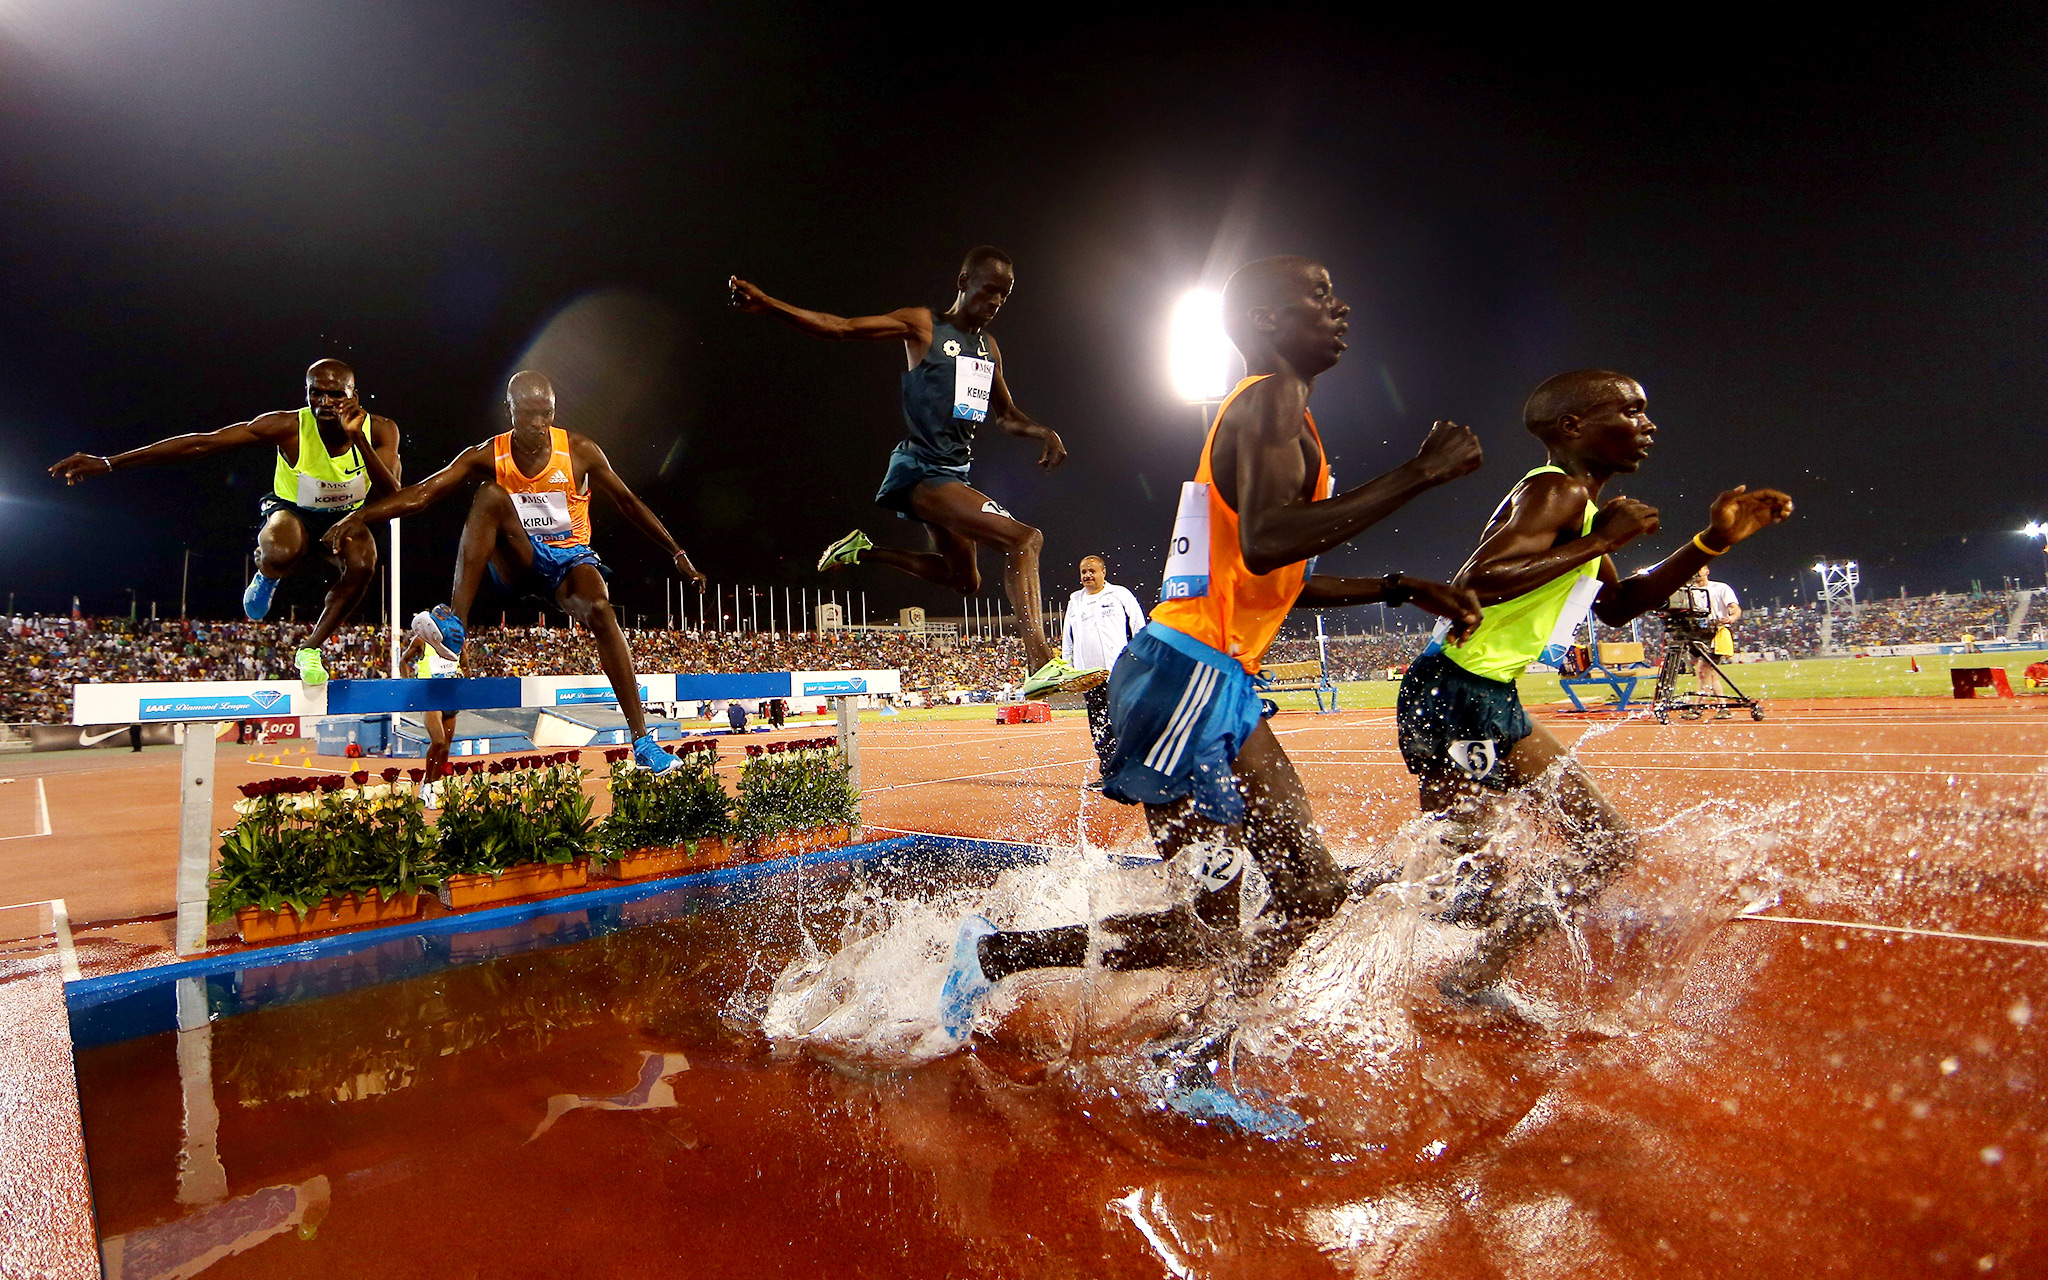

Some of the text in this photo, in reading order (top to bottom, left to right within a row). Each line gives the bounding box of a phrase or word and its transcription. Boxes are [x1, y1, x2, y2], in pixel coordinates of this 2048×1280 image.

[327, 482, 351, 490] MSC
[314, 493, 354, 503] KOECH
[527, 495, 549, 504] MSC
[523, 517, 553, 528] KIRUI
[534, 533, 565, 543] Doha
[145, 702, 251, 713] IAAF Diamond League
[1467, 742, 1488, 771] 6
[1201, 845, 1233, 880] 12
